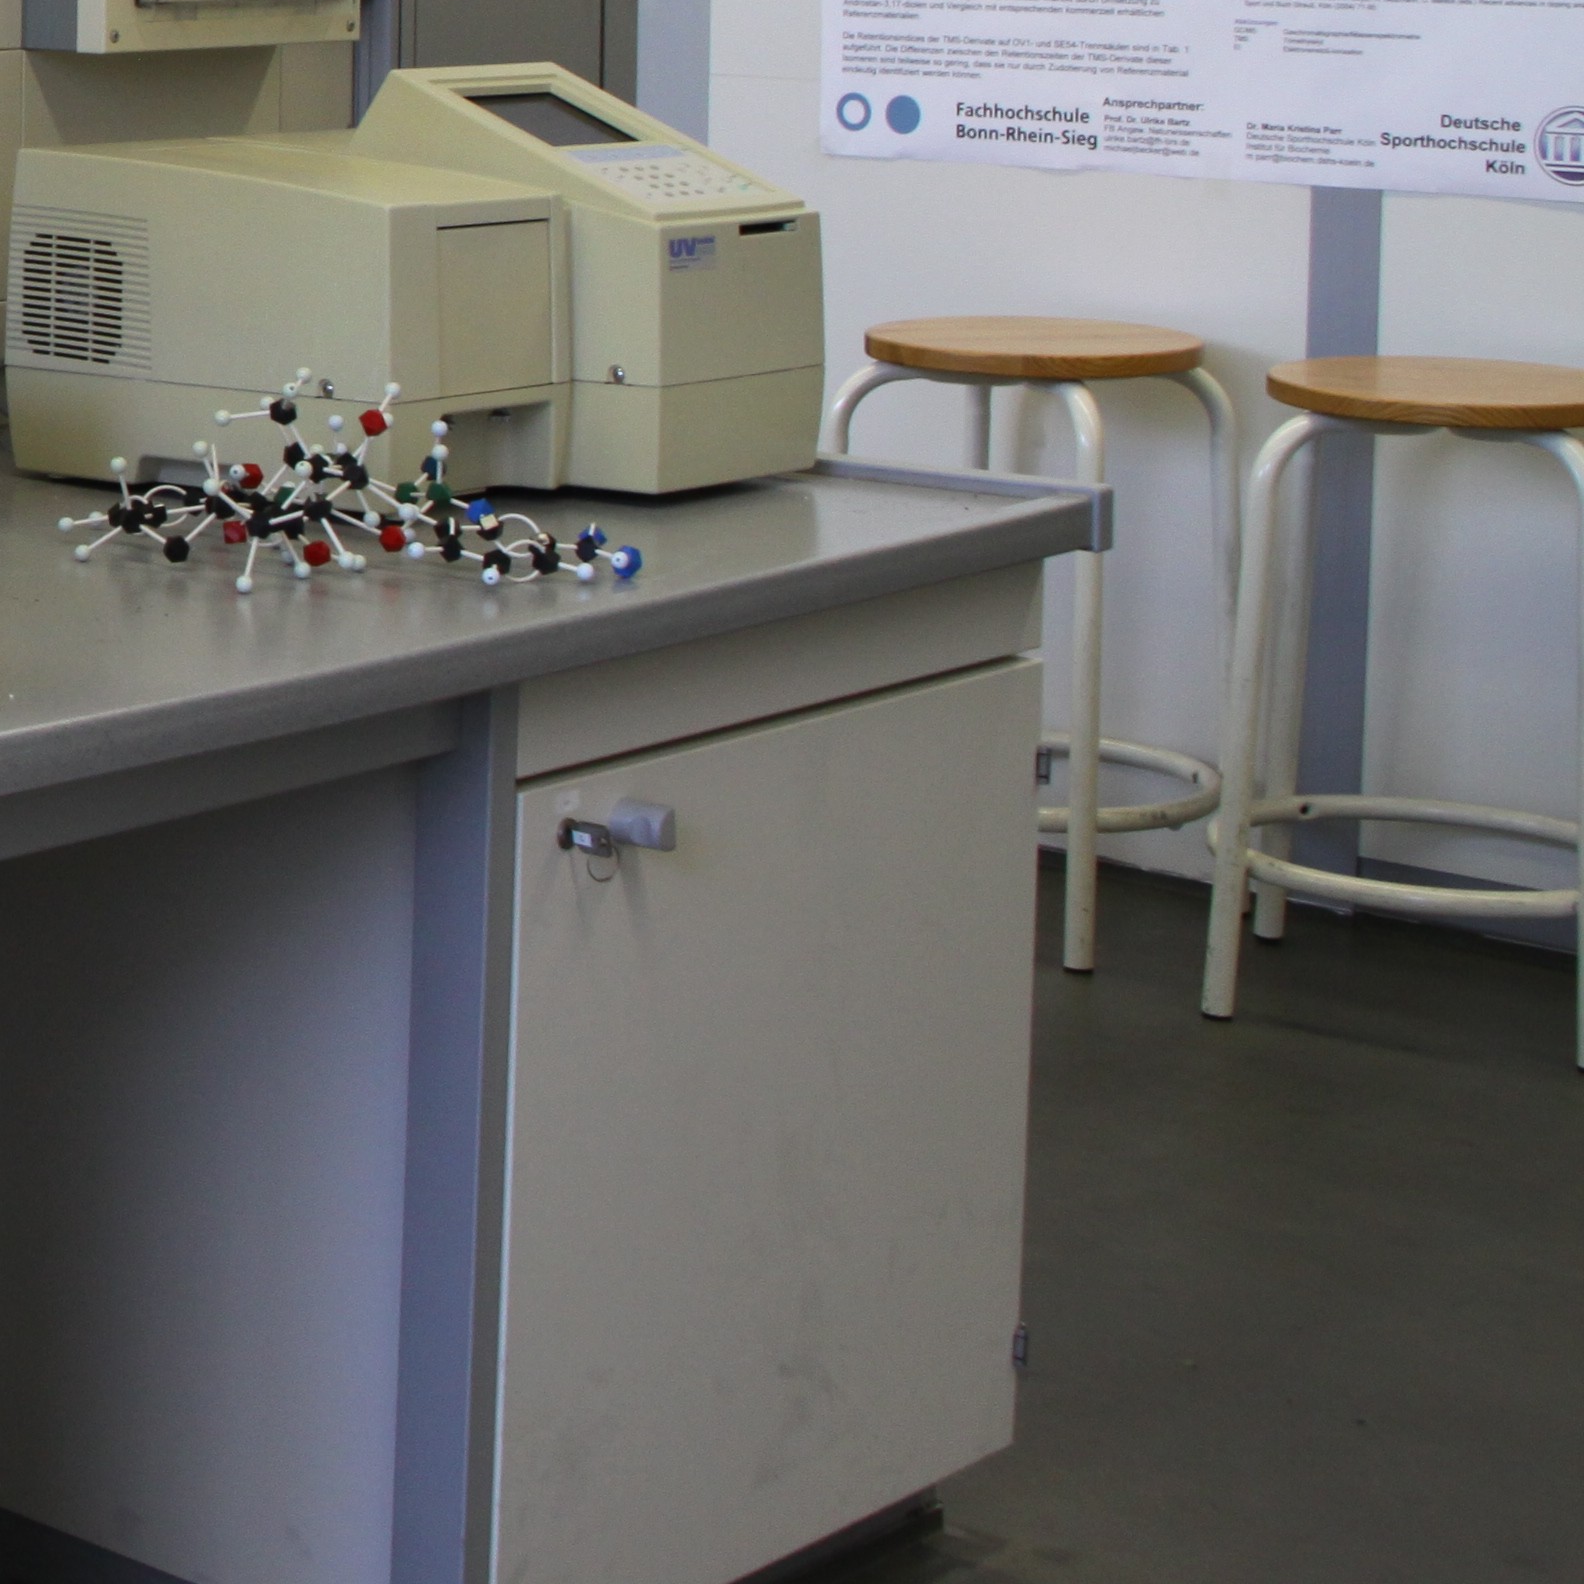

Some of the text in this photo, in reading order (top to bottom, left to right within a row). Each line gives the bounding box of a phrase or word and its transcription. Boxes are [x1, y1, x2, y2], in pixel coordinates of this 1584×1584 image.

[955, 101, 1090, 123] Fachhochschule
[1102, 96, 1203, 111] Ansprechpartner:
[1439, 113, 1522, 132] Deutsche
[955, 123, 1098, 150] Bonn-Rhein-Sieg
[1380, 131, 1526, 153] Sporthochschule
[1485, 159, 1526, 174] Köln
[670, 238, 696, 258] UV
